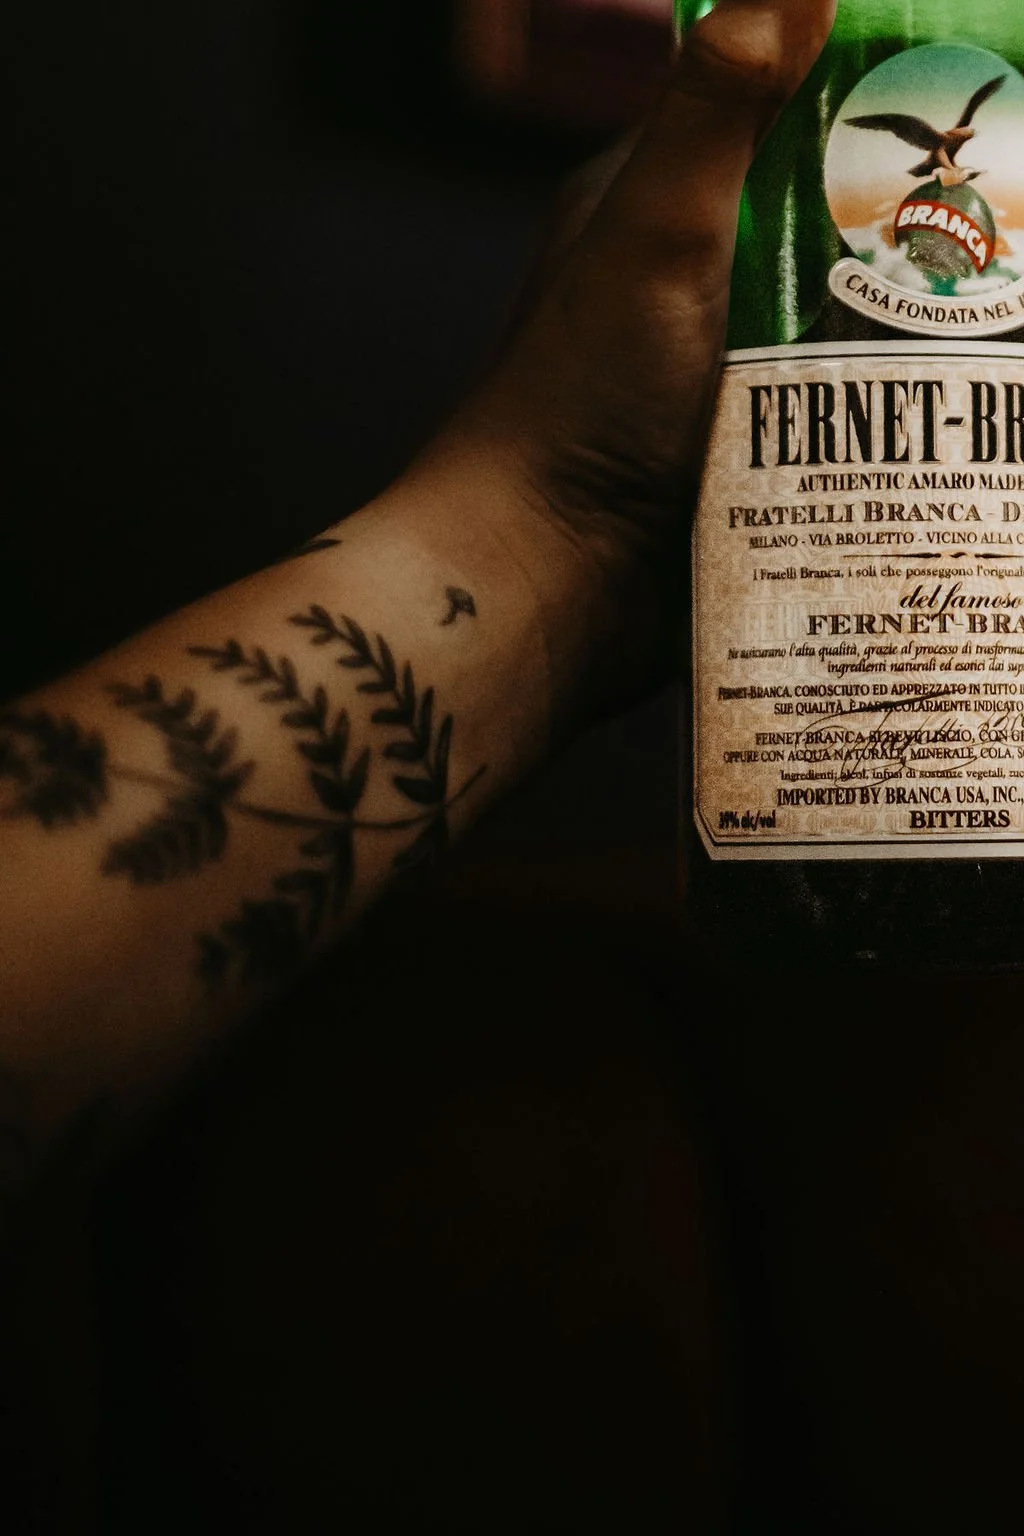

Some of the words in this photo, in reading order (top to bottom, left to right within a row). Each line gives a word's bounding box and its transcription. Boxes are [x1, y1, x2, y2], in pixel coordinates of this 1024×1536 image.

[897, 204, 987, 266] BRANCA
[845, 273, 890, 309] CASA
[895, 298, 979, 324] FONDATA
[983, 301, 1014, 321] NEL
[797, 473, 905, 492] AUTHENTIC
[908, 472, 974, 490] AMARO
[728, 503, 855, 528] FRATELLI
[864, 501, 983, 522] BRANCA
[750, 534, 798, 550] MILANO
[809, 533, 832, 546] VIA
[836, 532, 914, 545] BROLETTO
[926, 531, 977, 545] VICINO
[981, 532, 1013, 545] ALLA
[760, 567, 796, 580] Fratelli
[800, 567, 843, 580] Branca,
[856, 565, 876, 578] soli
[881, 565, 902, 577] che
[906, 567, 973, 580] posseggono
[900, 584, 942, 609] del
[931, 581, 1024, 621] famoso
[789, 642, 815, 657] l'alta
[818, 641, 860, 661] qualità,
[863, 642, 898, 660] grazie
[901, 640, 915, 654] al
[913, 643, 958, 660] processo
[961, 640, 972, 655] di
[828, 659, 887, 678] ingredienti
[890, 657, 936, 672] naturali
[939, 657, 951, 671] ed
[954, 658, 985, 672] esotici
[794, 683, 870, 697] CONOSCIUTO
[873, 683, 889, 696] ED
[891, 683, 967, 697] APPREZZATO
[969, 683, 981, 695] IN
[982, 683, 1017, 695] TUTTO
[774, 702, 794, 715] SUE
[974, 700, 1024, 712] INDICATO
[755, 730, 865, 745] FERNET-BRANCA
[979, 729, 1008, 742] CON
[761, 750, 784, 762] CON
[788, 749, 831, 763] ACQUA
[910, 747, 978, 760] MINERALE,
[980, 747, 1015, 760] COLA,
[906, 768, 916, 778] di
[920, 768, 963, 779] sostanze
[966, 767, 1006, 780] vegetali,
[777, 787, 856, 806] IMPORTED
[860, 786, 882, 805] BY
[885, 786, 952, 805] BRANCA
[956, 786, 989, 806] USA,
[909, 809, 1011, 829] BITTERS
